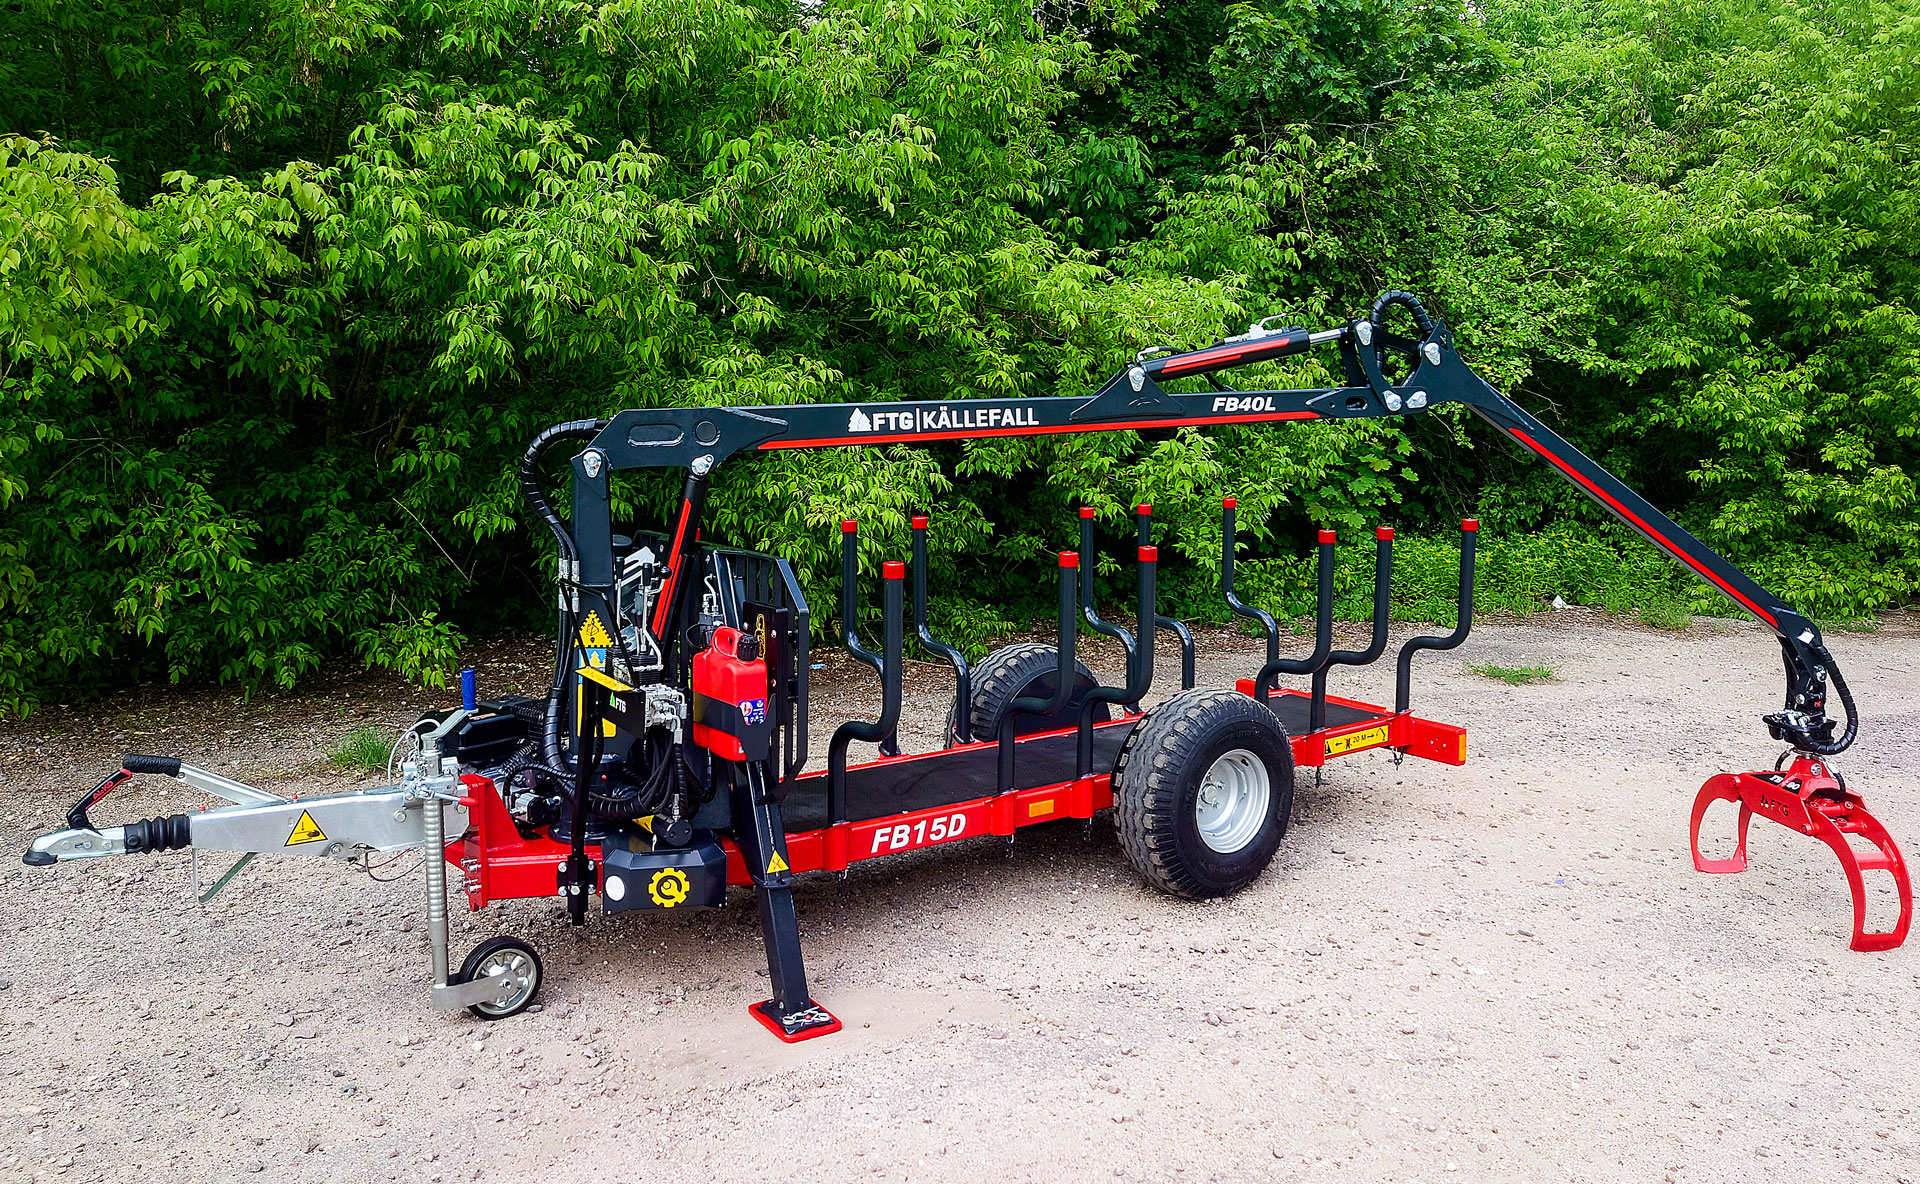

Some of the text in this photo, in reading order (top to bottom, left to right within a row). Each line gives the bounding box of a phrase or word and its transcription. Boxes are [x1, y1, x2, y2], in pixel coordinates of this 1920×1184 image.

[1212, 396, 1276, 412] FB40L
[872, 406, 1040, 431] FTG KÄLLEFALL
[615, 697, 627, 713] FTG
[1771, 799, 1789, 817] FTG
[870, 813, 966, 854] FB15D
